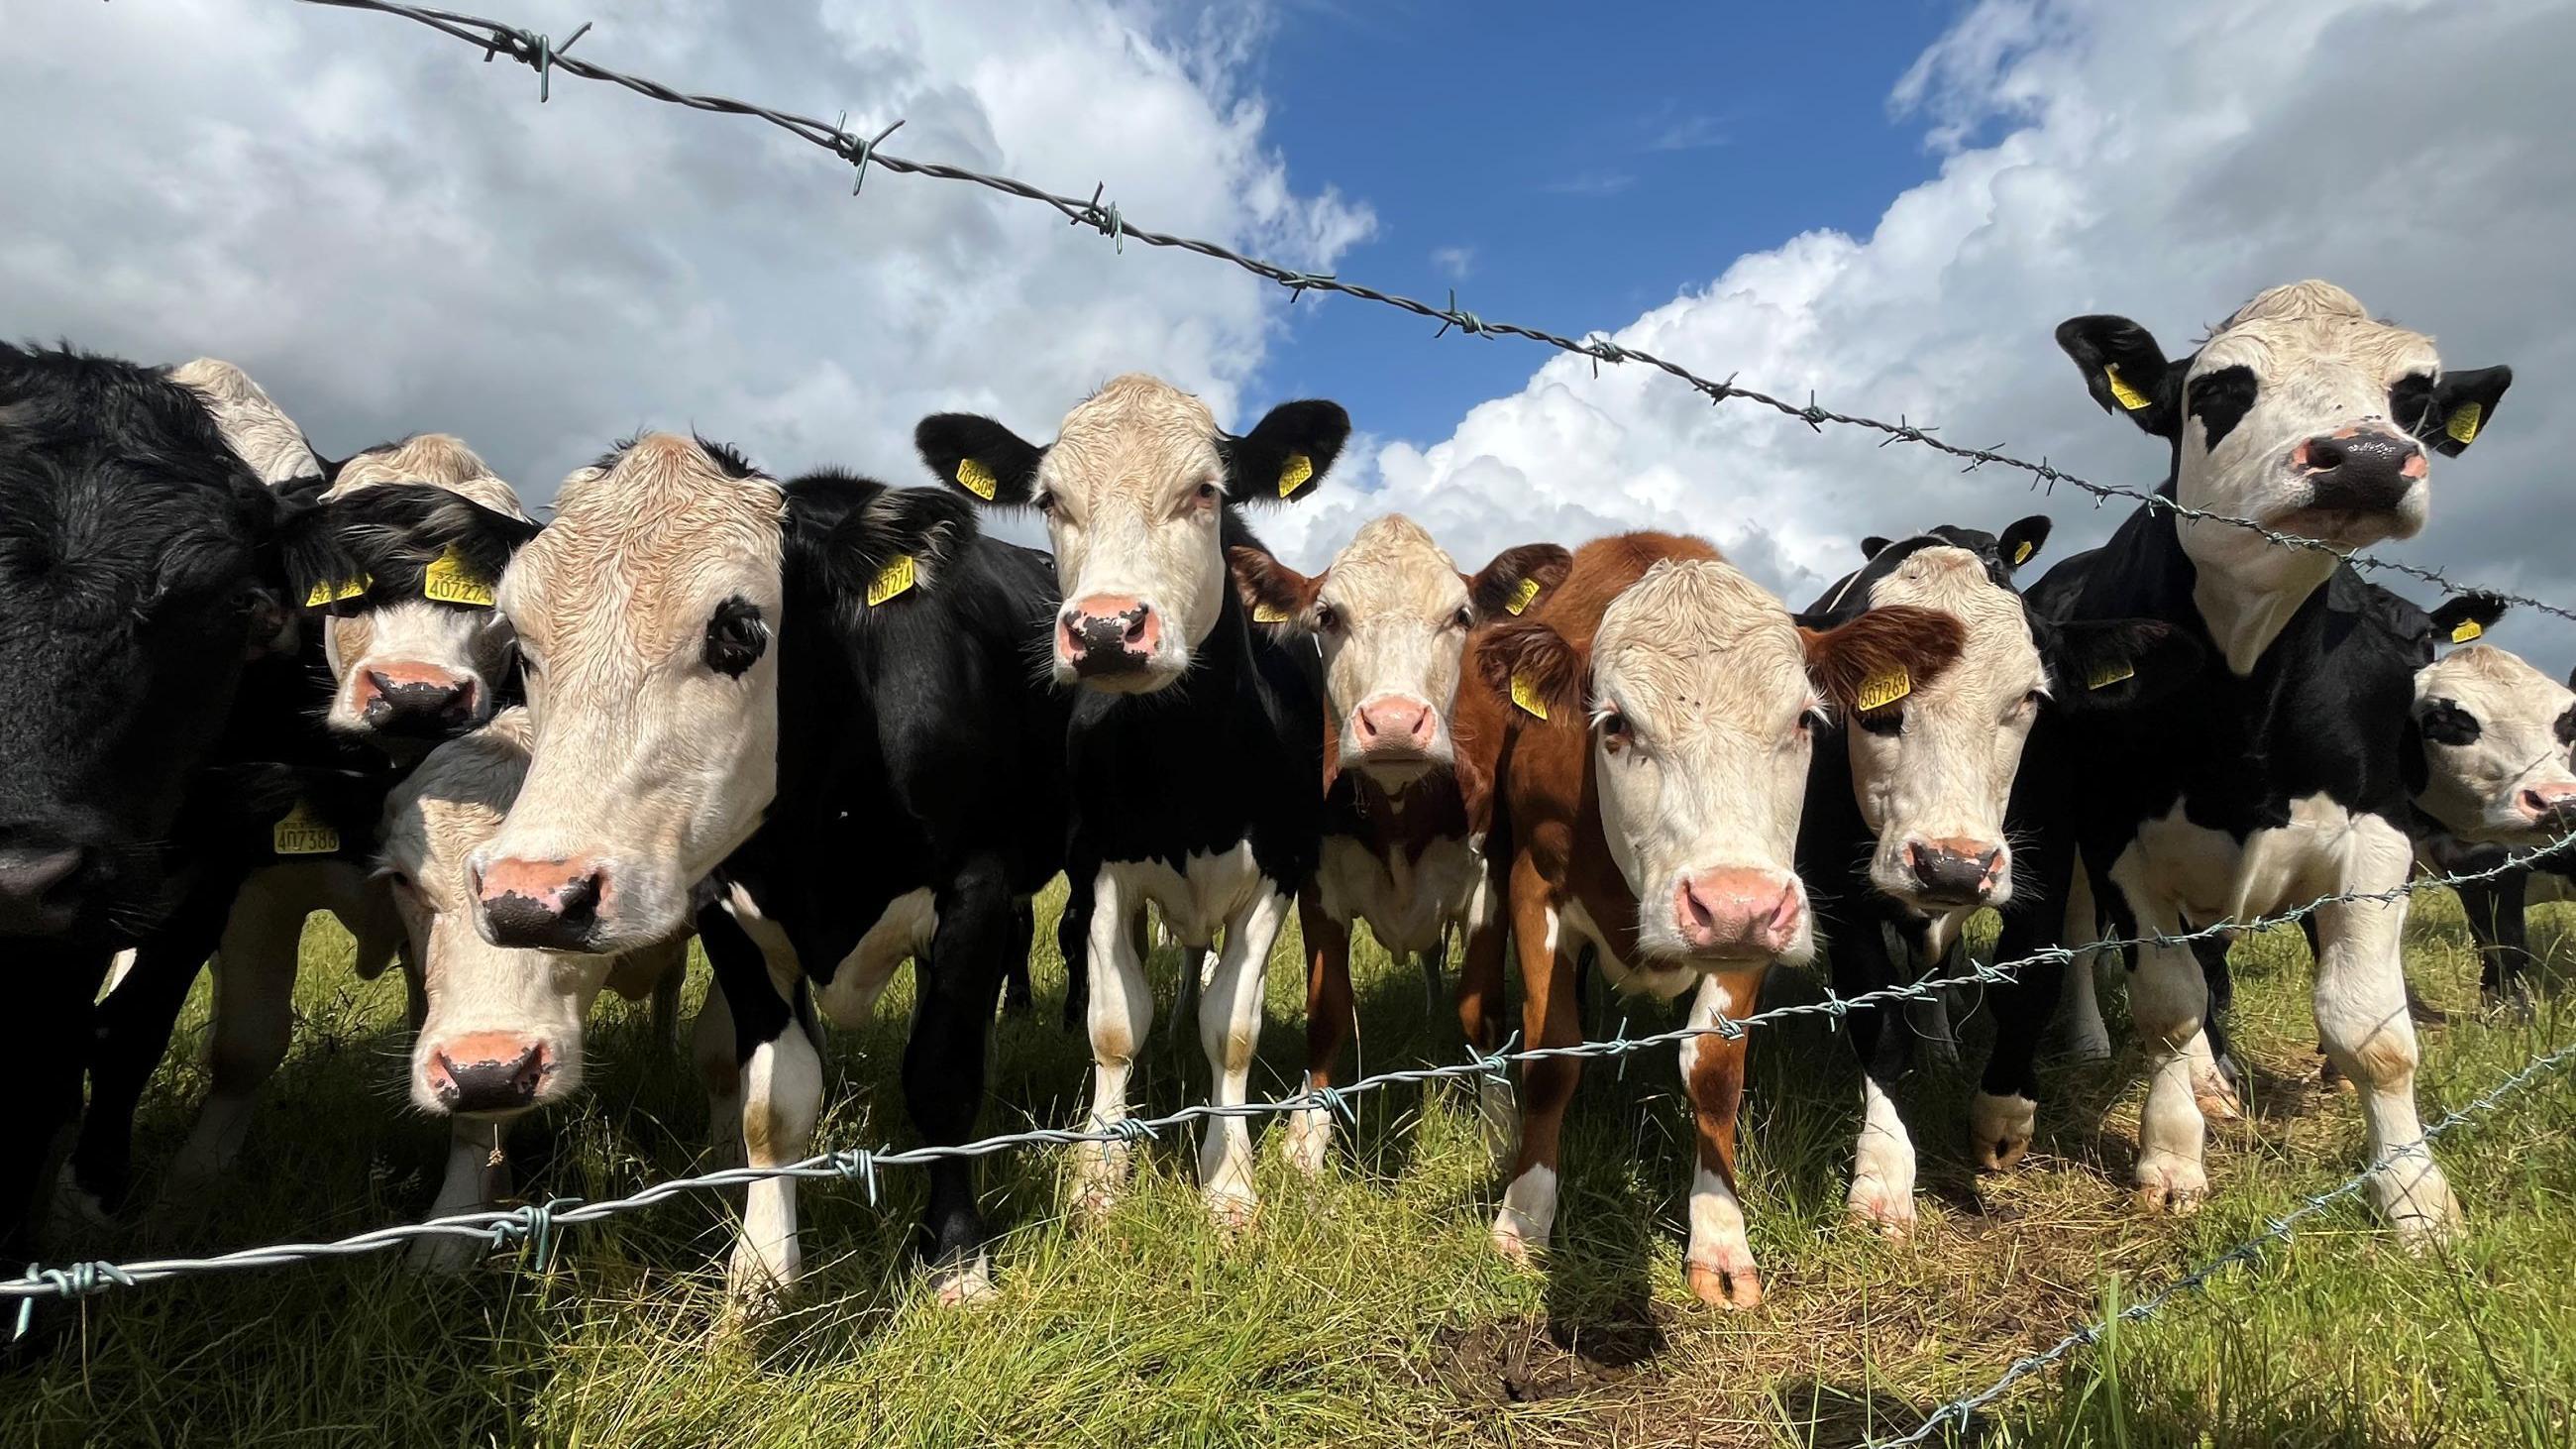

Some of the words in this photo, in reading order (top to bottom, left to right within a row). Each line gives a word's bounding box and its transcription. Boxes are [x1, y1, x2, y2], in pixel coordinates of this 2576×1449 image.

[959, 465, 994, 498] 707305
[429, 580, 492, 603] 407274
[870, 564, 912, 603] 407274
[1861, 674, 1905, 708] 607269
